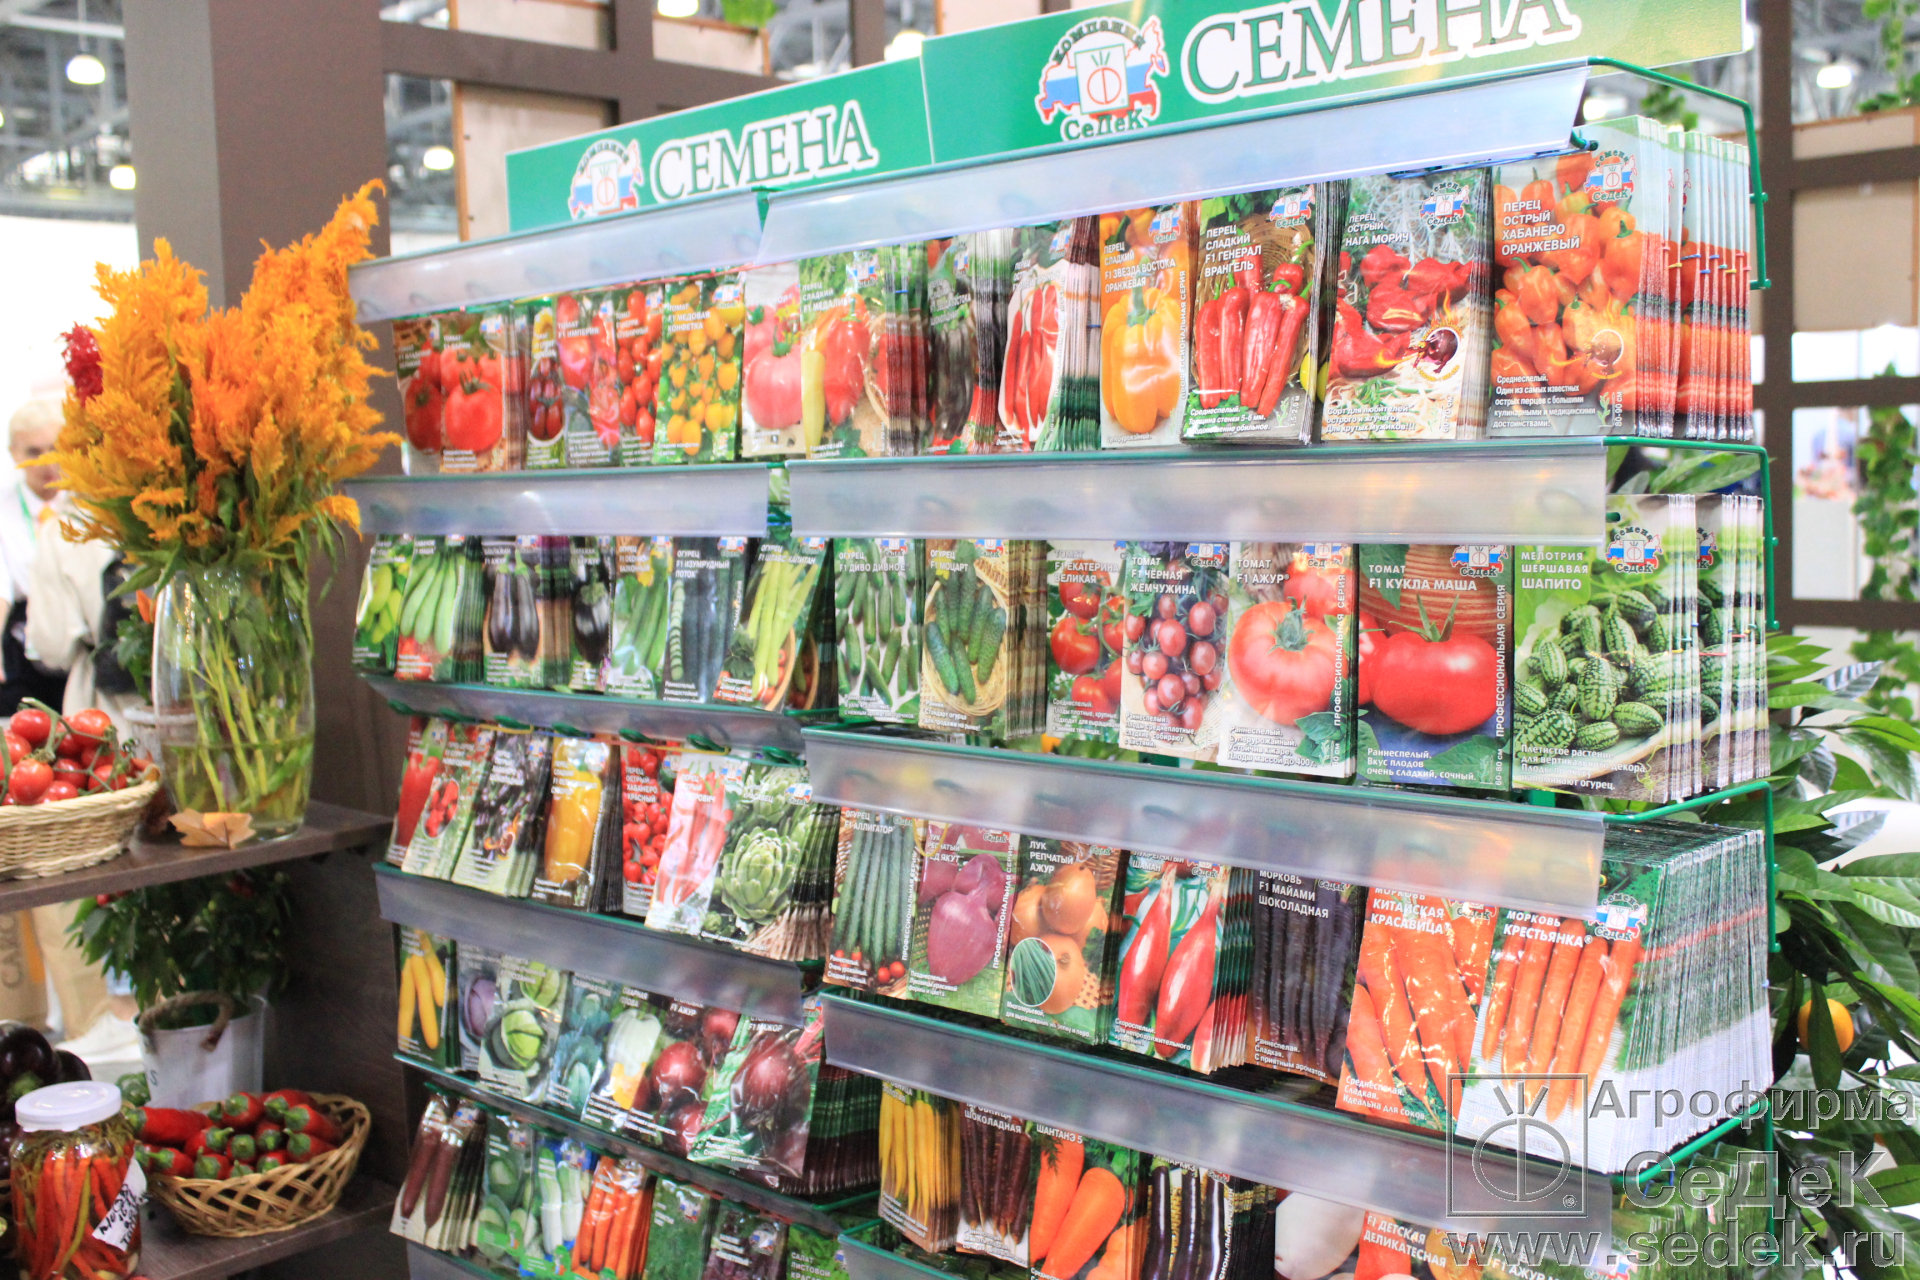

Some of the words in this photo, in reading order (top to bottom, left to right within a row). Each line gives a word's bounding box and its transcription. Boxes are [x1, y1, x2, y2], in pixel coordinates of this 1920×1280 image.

[1186, 0, 1575, 97] СЕМЕНА
[652, 102, 876, 200] СЕМЕНА
[1593, 189, 1630, 202] СеДеК
[1503, 199, 1542, 213] ПЕРЕЦ
[1275, 216, 1306, 229] СеДеК
[1349, 213, 1377, 223] ПЕРЕЦ
[1426, 215, 1460, 226] СеДеК
[1502, 209, 1551, 227] ОСТРЫЙ
[1206, 225, 1237, 238] ПЕРЕЦ
[1347, 220, 1384, 234] ОСТРЫЙ
[1501, 223, 1566, 241] ХАБАНЕРО
[1206, 233, 1250, 252] СЛАДКИЙ
[1345, 235, 1370, 247] НАГА
[1371, 231, 1409, 245] МОРИЧ
[1104, 242, 1125, 254] ПЕРЕЦ
[1501, 236, 1580, 256] ОРАНЖЕВЫЙ
[1104, 252, 1135, 266] СЛАДКИЙ
[1205, 253, 1215, 264] F1
[1218, 245, 1262, 262] ГЕНЕРАЛ
[1105, 270, 1112, 280] F1
[1112, 264, 1141, 278] ЗВЕЗДА
[1141, 258, 1176, 273] ВОСТОКА
[1204, 260, 1255, 278] ВРАНГЕЛЬ
[1105, 277, 1147, 293] ОРАНЖЕВАЯ
[803, 288, 834, 301] СЛАДКИЙ
[675, 311, 711, 321] МЕДОВАЯ
[668, 323, 704, 333] КОНФЕТКА
[1496, 374, 1548, 384] Среднеспелый.
[1496, 386, 1513, 395] Один
[1524, 385, 1546, 394] самых
[1547, 384, 1580, 393] известных
[1495, 397, 1517, 406] острых
[1494, 408, 1541, 417] кулинарными
[1493, 420, 1550, 429] достоинствами.
[677, 550, 700, 559] ОГУРЕЦ
[761, 545, 783, 553] ОГУРЕЦ
[931, 550, 956, 560] ОГУРЕЦ
[1055, 550, 1084, 559] ТОМАТ
[765, 554, 816, 564] ШТАБС-КАПИТАН
[839, 552, 865, 561] ОГУРЕЦ
[1132, 557, 1161, 566] ТОМАТ
[1192, 557, 1218, 568] СеДеК
[1521, 551, 1584, 562] МЕЛОТРИЯ
[685, 560, 730, 570] ИЗУМРУДНЫЙ
[849, 563, 871, 573] ДИВО
[872, 563, 906, 573] ДИВНОЕ
[940, 562, 968, 572] МОЦАРТ
[1055, 562, 1065, 570] F1
[1067, 562, 1119, 573] ЕКАТЕРИНА
[1237, 559, 1272, 569] ТОМАТ
[1369, 564, 1406, 574] ТОМАТ
[1521, 563, 1588, 574] ШЕРШАВАЯ
[1615, 563, 1653, 574] СеДеК
[1054, 574, 1097, 584] ВЕЛИКАЯ
[1131, 568, 1142, 578] F1
[1145, 567, 1183, 581] ЧЁРНАЯ
[1236, 574, 1249, 583] F1
[1460, 567, 1498, 578] СеДеК
[1131, 583, 1197, 595] ЖЕМЧУЖИНА
[1369, 578, 1382, 589] F1
[1386, 578, 1430, 590] КУКЛА
[1433, 579, 1478, 591] МАША
[1521, 578, 1582, 590] ШАПИТО
[1338, 574, 1346, 609] СЕРИЯ
[1497, 584, 1506, 619] СЕРИЯ
[1334, 613, 1345, 727] ПРОФЕССИОНАЛЬНАЯ
[1495, 623, 1506, 737] ПРОФЕССИОНАЛЬНАЯ
[1229, 725, 1283, 737] Раннеспелый.
[1229, 734, 1298, 748] Суперурожайный.
[1228, 752, 1251, 763] Плоды
[1253, 755, 1282, 765] массой
[1367, 748, 1432, 760] Раннеспелый.
[1521, 744, 1570, 757] Плетистое
[1571, 747, 1614, 760] растение
[1367, 757, 1388, 768] Вкус
[1391, 759, 1424, 769] плодов
[1521, 755, 1540, 764] для
[1611, 762, 1648, 774] декора.
[626, 775, 650, 784] ОСТРЫЙ
[1366, 767, 1394, 777] очень
[1396, 768, 1438, 779] сладкий,
[1440, 771, 1477, 782] сочный.
[1521, 773, 1578, 787] напоминают
[1580, 780, 1616, 791] огурец.
[627, 784, 658, 794] ХАБАНЕРО
[845, 810, 870, 821] ОГУРЕЦ
[853, 822, 893, 835] АЛЛИГАТОР
[1030, 840, 1046, 851] ЛУК
[941, 854, 960, 863] ЯКУТ
[1030, 851, 1074, 865] РЕПЧАТЫЙ
[1030, 862, 1055, 874] АЖУР
[1132, 860, 1161, 872] ШАМАН
[1259, 870, 1302, 885] МОРКОВЬ
[1259, 881, 1269, 892] F1
[1272, 885, 1316, 902] МАЙАМИ
[992, 874, 1011, 969] ПРОФЕССИОНАЛЬНАЯ
[1006, 844, 1014, 873] СЕРИЯ
[1259, 895, 1329, 919] ШОКОЛАДНАЯ
[1373, 899, 1444, 919] КИТАЙСКАЯ
[902, 879, 914, 961] ПРОФЕССИОНАЛЬНАЯ
[1457, 907, 1490, 920] СеДеК
[1506, 910, 1561, 928] МОРКОВЬ
[1594, 926, 1633, 941] СеДеК
[678, 1006, 697, 1018] АЖУР
[1254, 1036, 1300, 1053] Раннеспелая.
[1254, 1045, 1284, 1059] Сладкая.
[1296, 1062, 1328, 1079] ароматом.
[1344, 1085, 1379, 1100] Сладкая.
[1343, 1094, 1381, 1112] Идеальна
[1383, 1103, 1399, 1115] для
[1400, 1108, 1428, 1120] соков.
[964, 1109, 1022, 1134] ШОКОЛАДНАЯ
[1036, 1123, 1076, 1143] ШАНТАНЭ
[1076, 1133, 1083, 1144] 5
[1366, 1213, 1377, 1227] F1
[1378, 1218, 1426, 1245] ДЕТСКАЯ
[1363, 1230, 1446, 1268] ДЕЛИКАТЕСНАЯ
